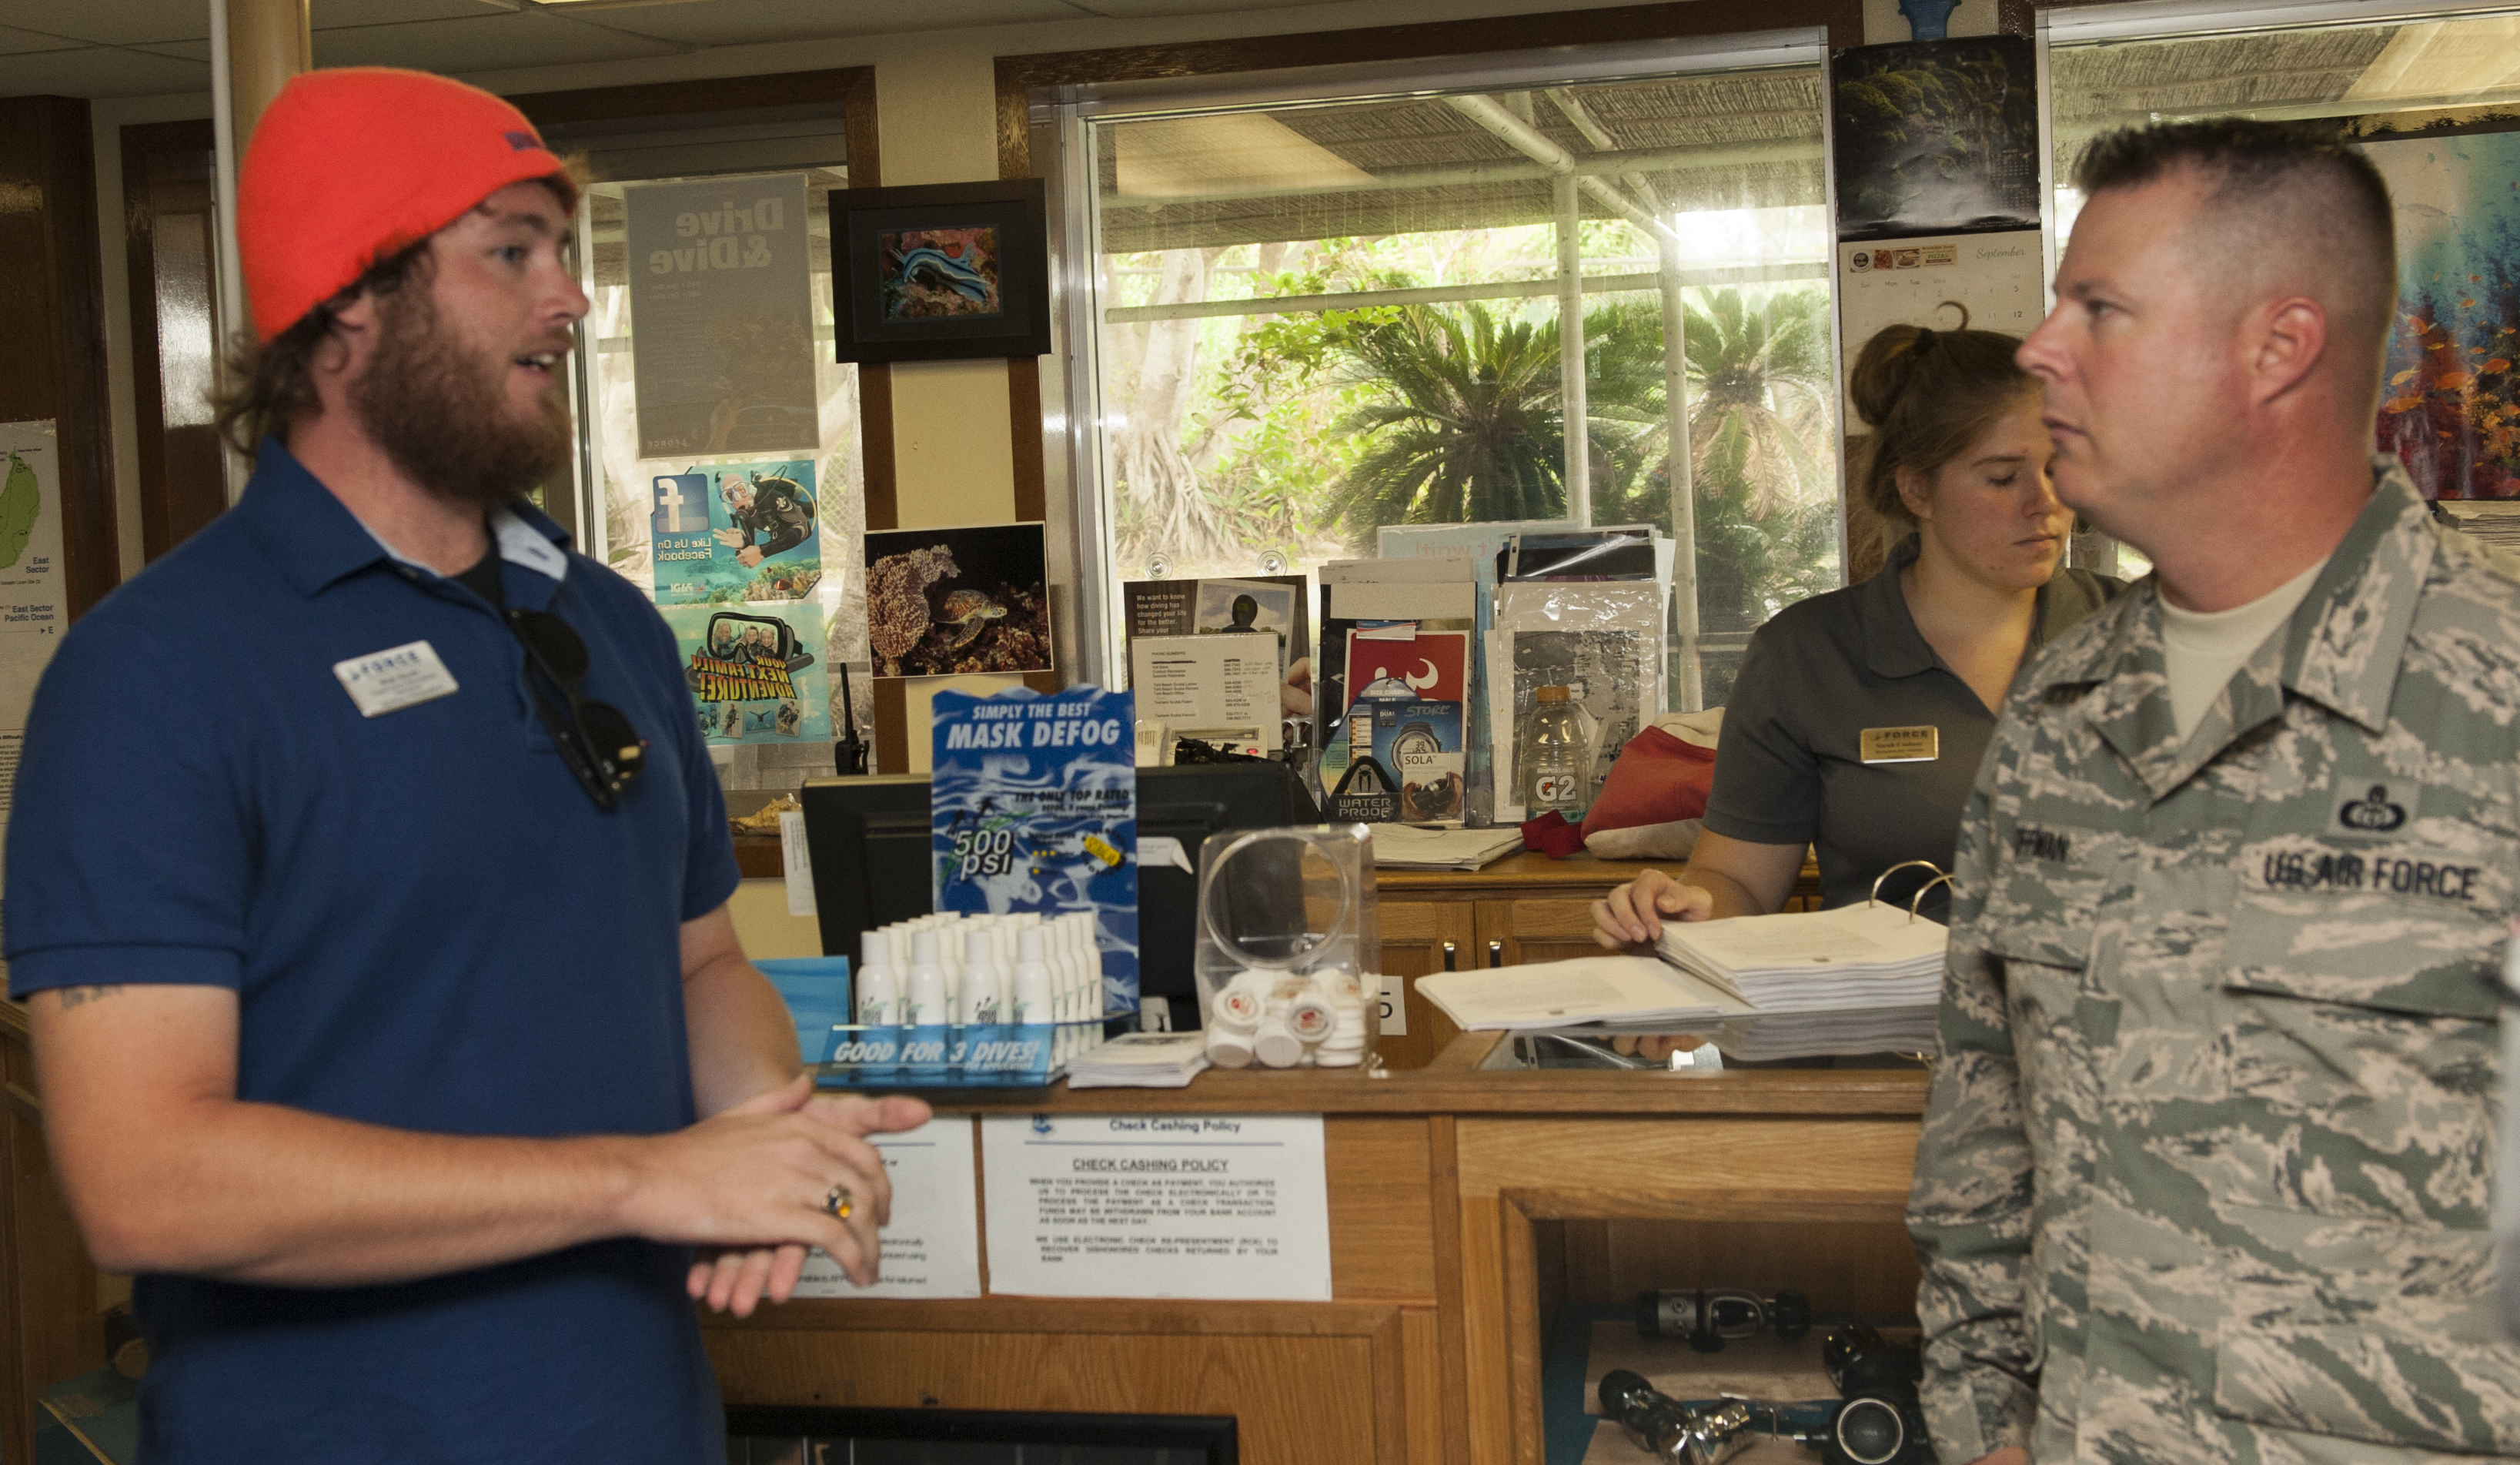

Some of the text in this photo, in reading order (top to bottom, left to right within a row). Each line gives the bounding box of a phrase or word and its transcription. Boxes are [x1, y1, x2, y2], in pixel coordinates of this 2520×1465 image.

[1977, 246, 2026, 260] September
[12, 604, 53, 614] East Sector
[31, 613, 54, 621] Ocean
[972, 702, 1092, 720] SIMPLY THE BEST
[1404, 705, 1451, 717] STORE
[946, 718, 1121, 750] MASK DEFOG
[1536, 774, 1577, 801] G2
[1015, 789, 1129, 802] THE ONLY TOP RATED
[1339, 798, 1392, 808] WATER
[954, 830, 1011, 856] 500
[960, 853, 1011, 881] psi
[2314, 853, 2365, 886] AIR
[2374, 856, 2480, 901] FORCE
[834, 1041, 1041, 1063] GOOD FOR 3 DIVES!
[1110, 1119, 1241, 1134] Check Cashing Policy
[1073, 1158, 1228, 1172] CHECK CASHING POLICY
[1073, 1236, 1123, 1244] ELECTRONIC
